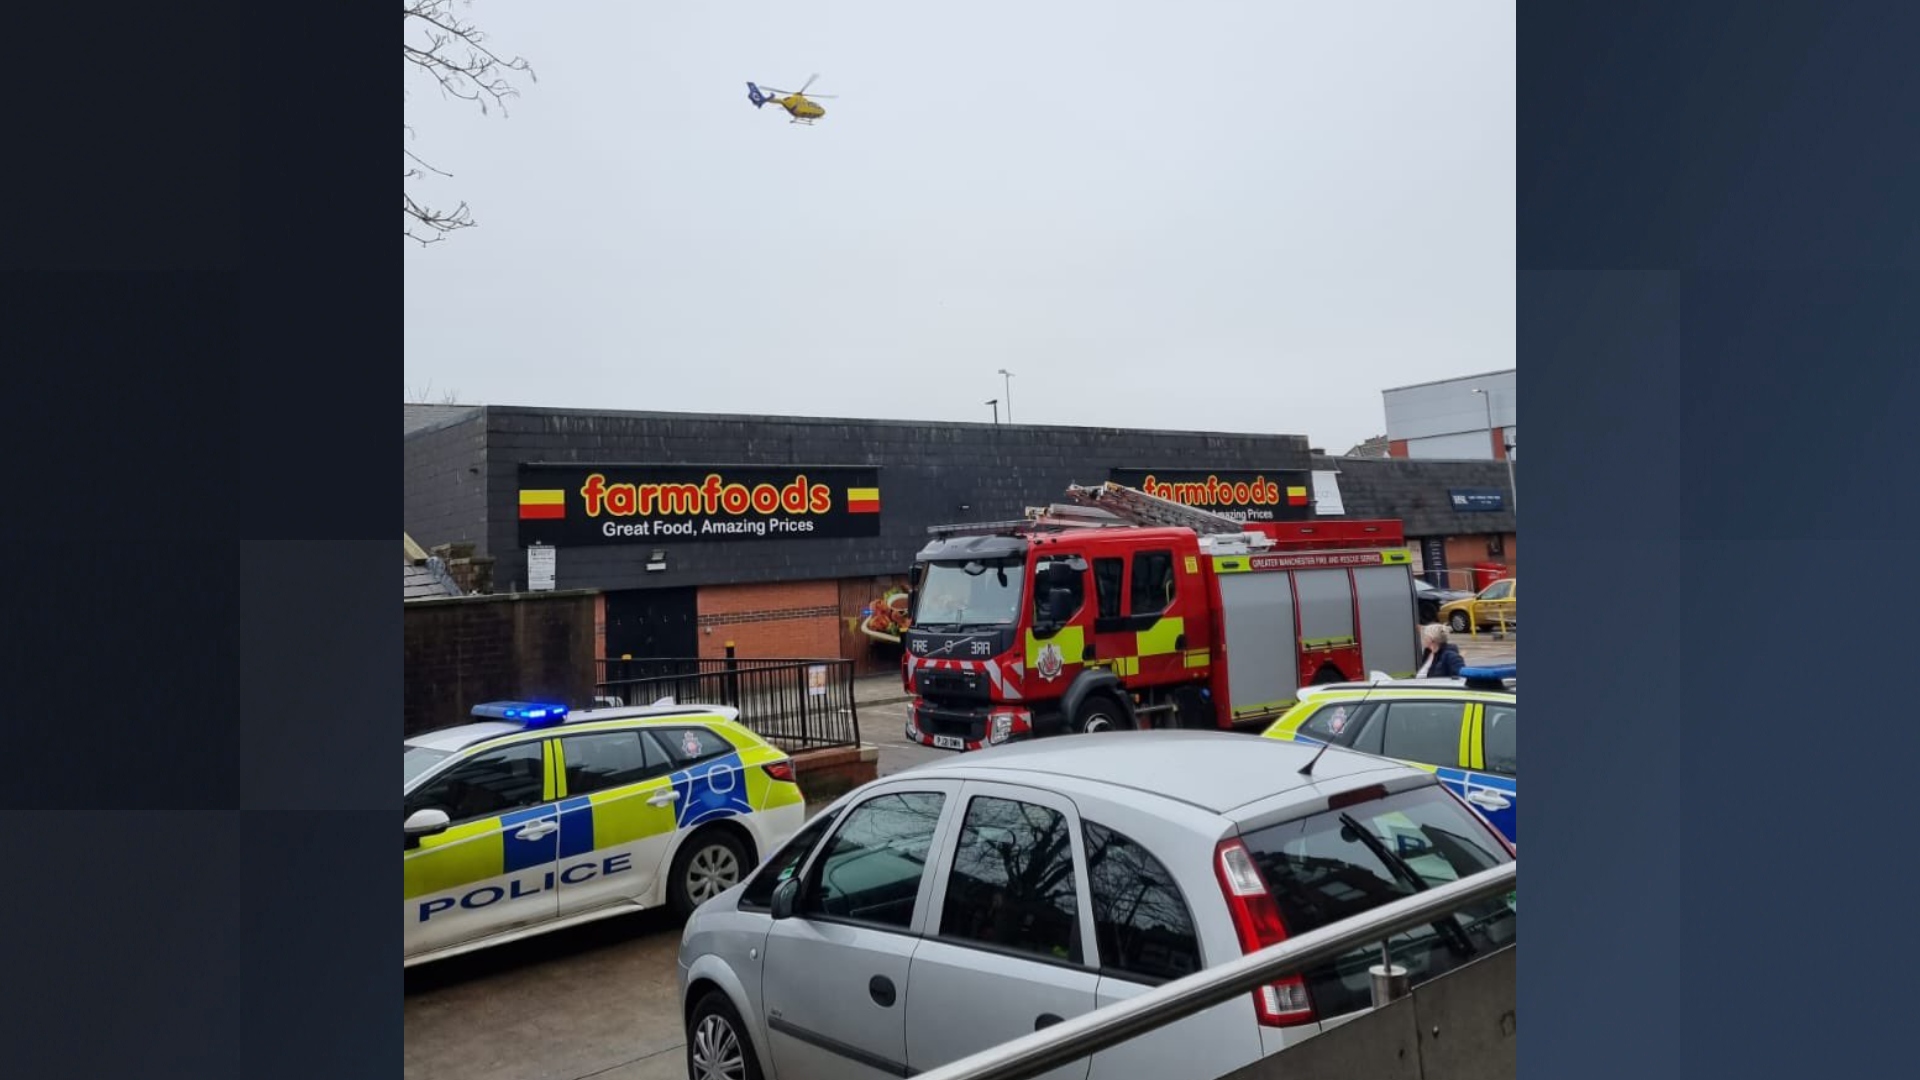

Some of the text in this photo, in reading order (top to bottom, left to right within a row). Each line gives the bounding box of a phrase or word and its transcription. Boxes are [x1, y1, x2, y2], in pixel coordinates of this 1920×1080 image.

[580, 473, 832, 517] farmfoods
[1143, 475, 1280, 506] farmfoods
[1247, 508, 1274, 520] Prices
[602, 517, 815, 537] Great Food, Amazing Prices
[1252, 558, 1278, 568] GREATER
[1279, 556, 1315, 567] MANCHESTER
[1360, 553, 1380, 563] SERVICE
[912, 640, 928, 653] FIRE
[419, 852, 632, 923] POLICE
